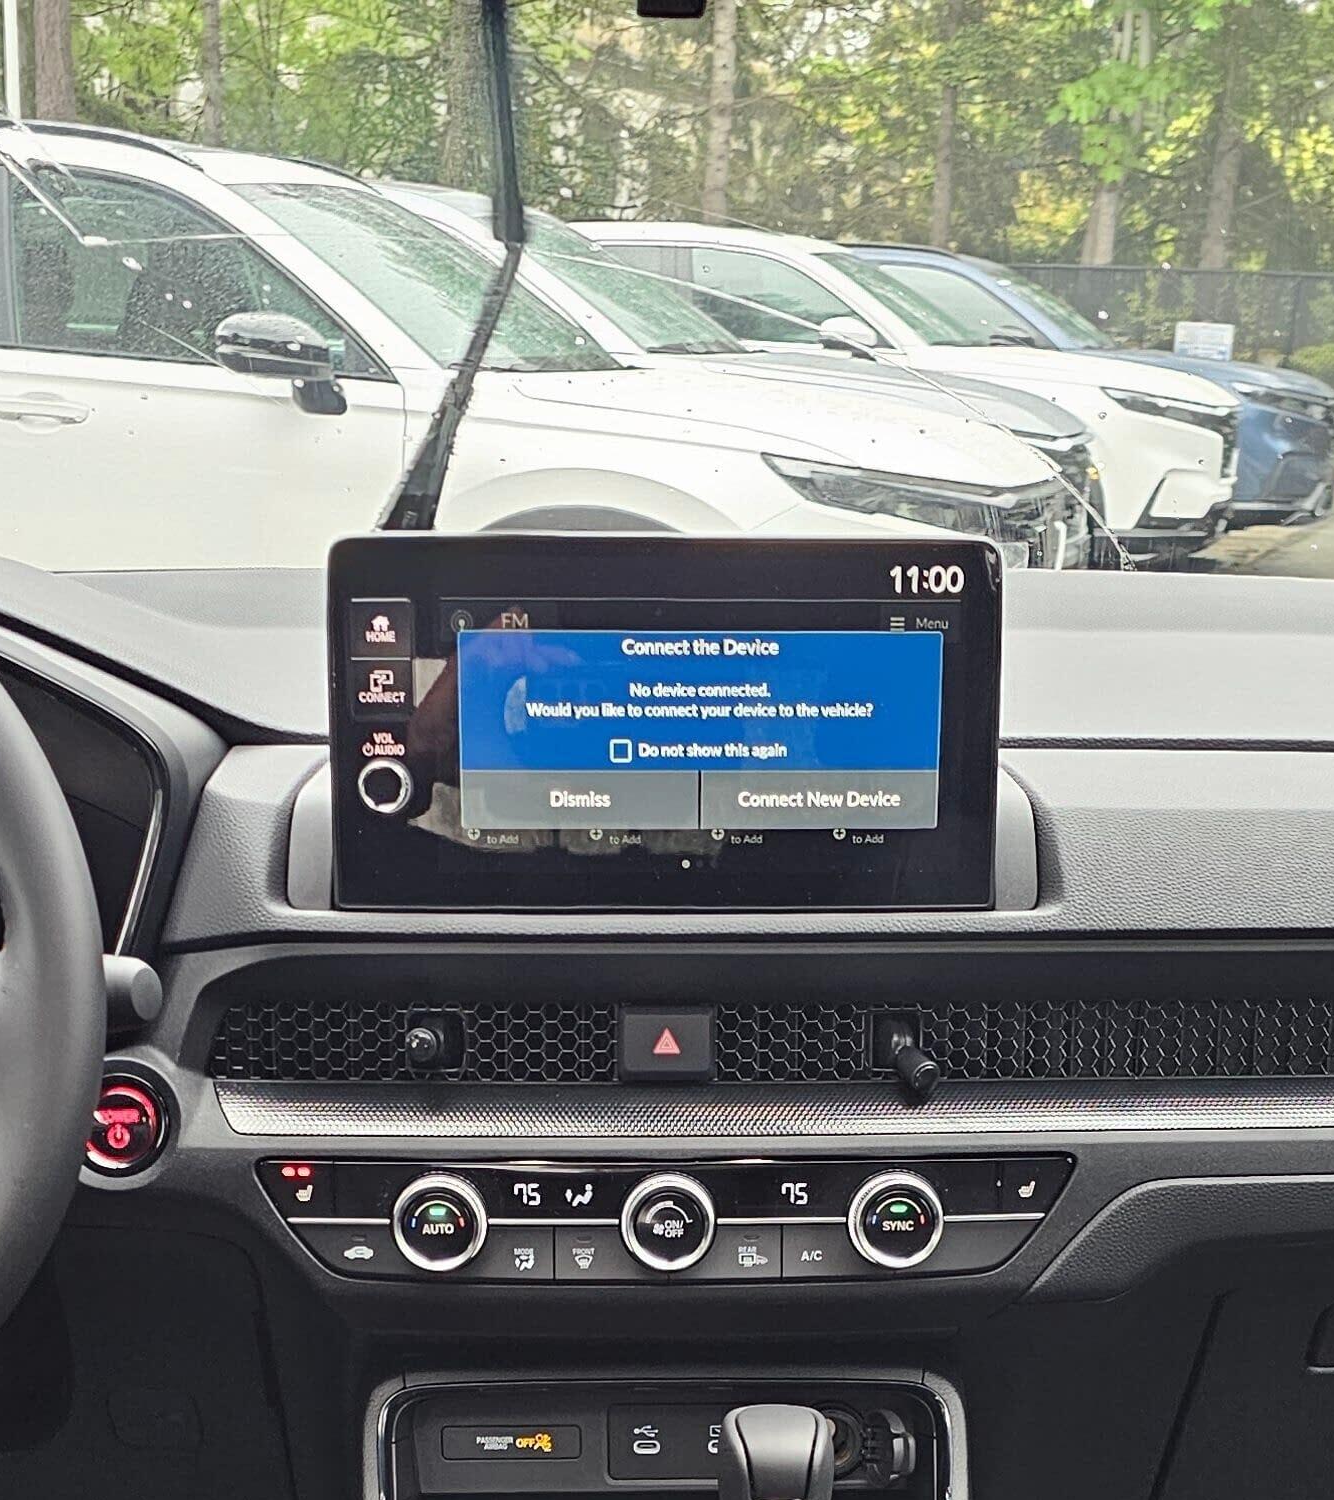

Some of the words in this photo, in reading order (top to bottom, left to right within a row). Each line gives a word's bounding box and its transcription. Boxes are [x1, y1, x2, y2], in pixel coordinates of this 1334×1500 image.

[889, 565, 965, 594] 11:00
[500, 613, 529, 628] FM
[915, 617, 949, 629] Menu
[365, 631, 396, 643] HOME
[621, 638, 691, 656] Connect
[692, 639, 720, 656] the
[723, 638, 780, 656] Device
[629, 682, 652, 698] No
[652, 682, 696, 698] device
[698, 683, 771, 698] connected.
[358, 691, 406, 703] CONNECT
[525, 702, 572, 718] Would
[573, 705, 600, 720] you
[601, 702, 625, 718] like
[627, 703, 643, 718] to
[644, 703, 699, 718] connect
[700, 705, 731, 720] your
[733, 702, 777, 718] device
[779, 703, 794, 718] to
[795, 703, 819, 718] the
[821, 702, 874, 718] vehicle?
[372, 732, 395, 744] VOL
[374, 744, 405, 756] AUDIO
[638, 743, 660, 758] Do
[661, 744, 686, 758] not
[686, 743, 722, 758] show
[724, 743, 750, 758] this
[751, 743, 788, 760] again
[549, 790, 612, 808] Dismiss
[737, 791, 804, 808] Connect
[807, 791, 844, 808] New
[846, 790, 901, 808] Device
[486, 835, 498, 845] to
[499, 834, 519, 844] Add
[609, 835, 620, 845] to
[621, 834, 642, 844] Add
[730, 835, 742, 845] to
[743, 834, 763, 844] Add
[852, 835, 863, 845] to
[864, 834, 884, 844] Add
[513, 1183, 541, 1206] 75
[781, 1183, 808, 1205] 75
[422, 1223, 454, 1235] AUTO
[664, 1219, 684, 1230] ON/
[882, 1220, 915, 1232] SYNC
[664, 1228, 684, 1238] OFF
[513, 1248, 534, 1256] MODE
[572, 1247, 595, 1255] FRONT
[800, 1250, 823, 1262] A/C
[515, 1438, 535, 1449] OFF
